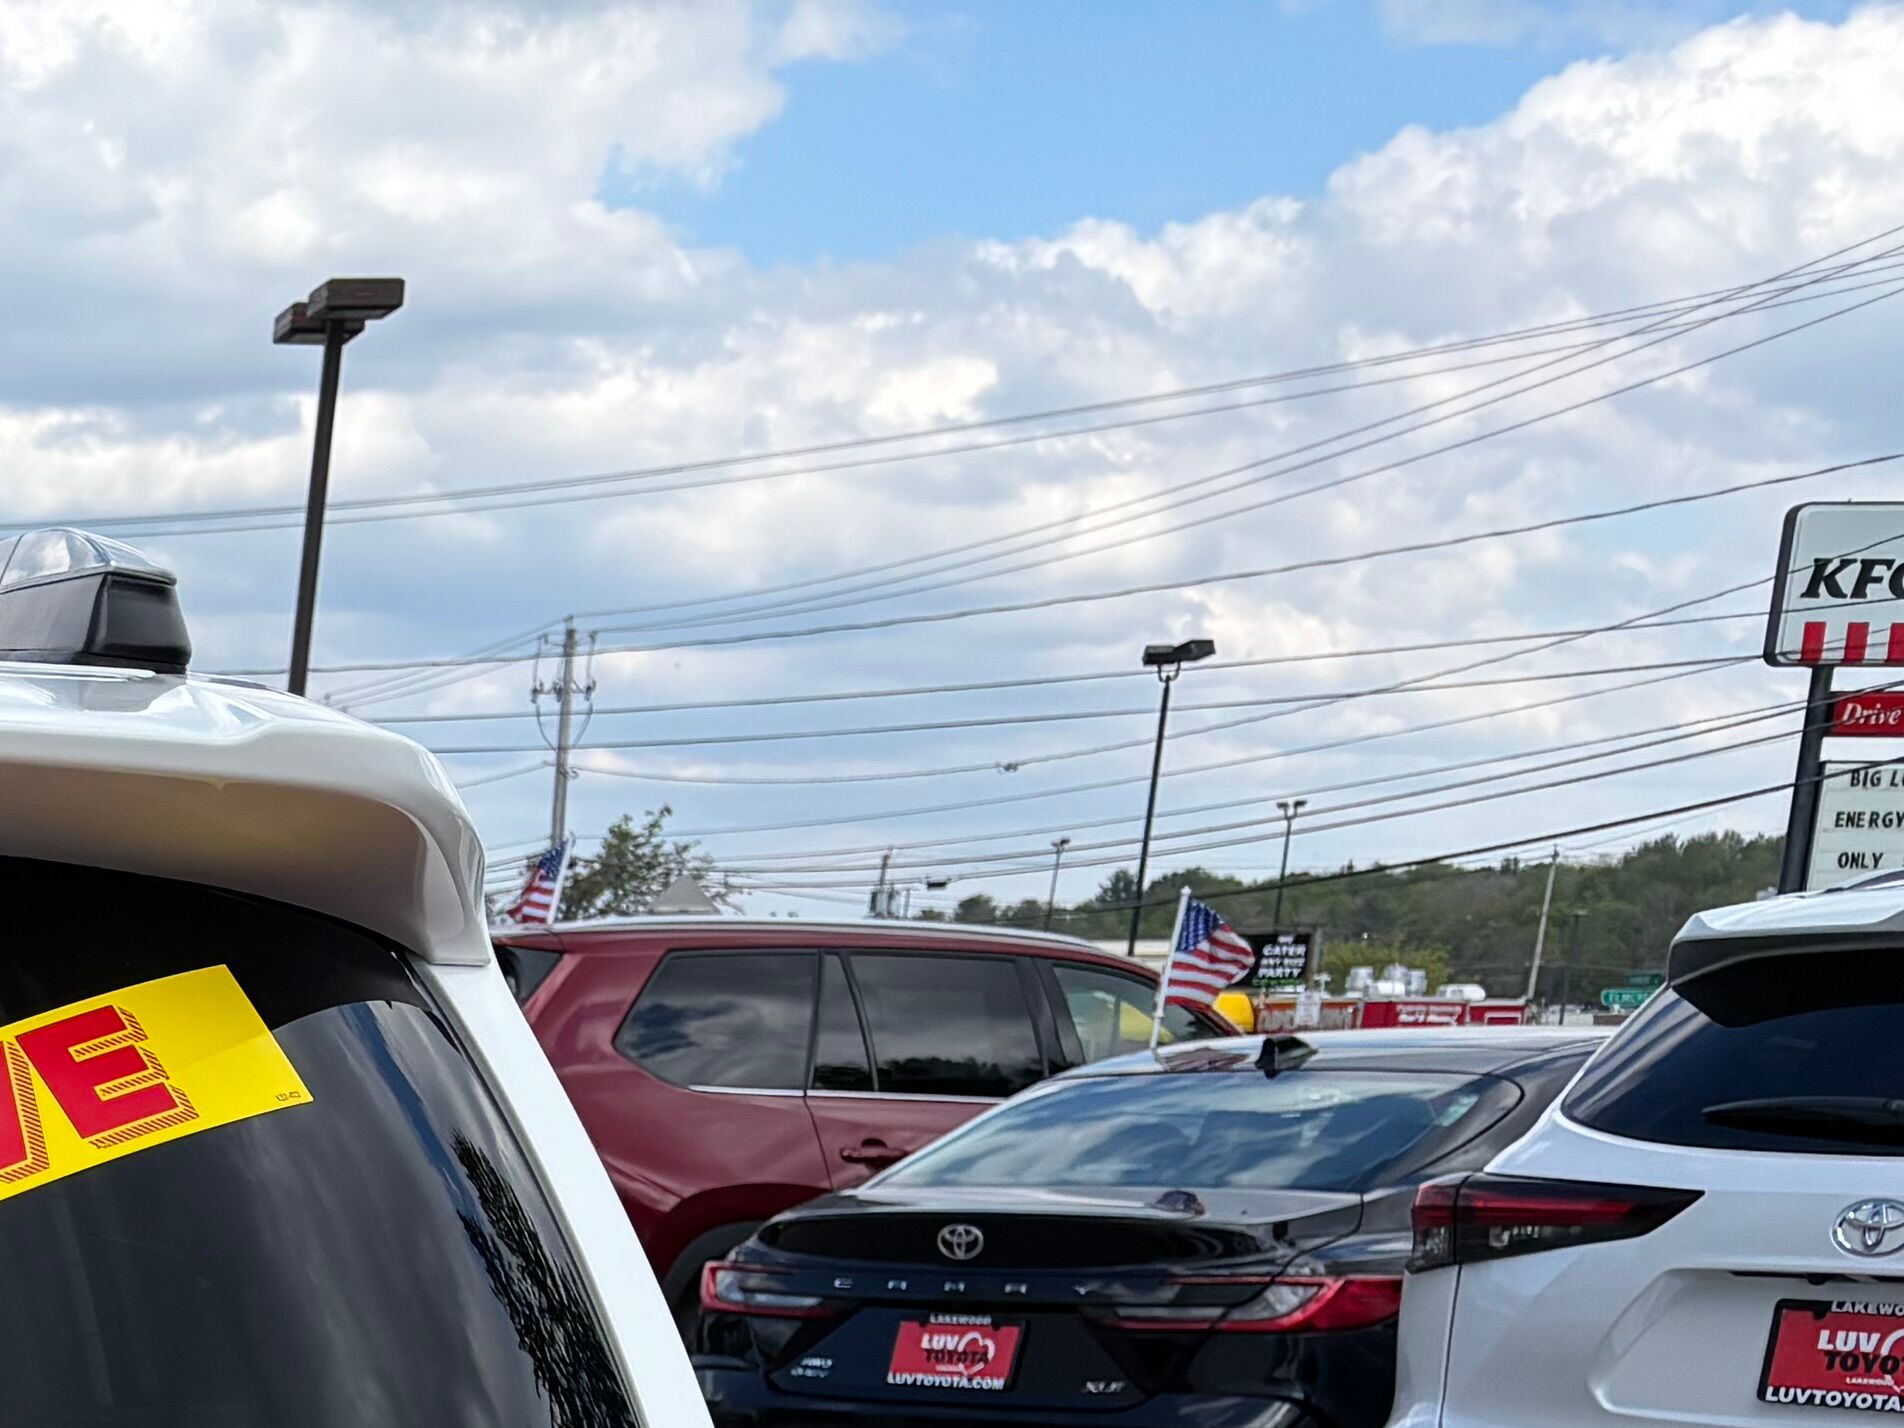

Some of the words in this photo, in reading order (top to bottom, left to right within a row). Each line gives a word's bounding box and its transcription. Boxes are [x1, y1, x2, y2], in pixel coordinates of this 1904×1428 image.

[1842, 702, 1902, 726] Drive
[1850, 768, 1882, 788] BIG
[1837, 852, 1884, 869] ONLY
[920, 1333, 960, 1351] LUV
[1817, 1329, 1881, 1353] LUV
[924, 1349, 990, 1366] TOYOTA
[1824, 1351, 1904, 1376] TOYO
[887, 1371, 1006, 1390] LUVTOYOTA.COM
